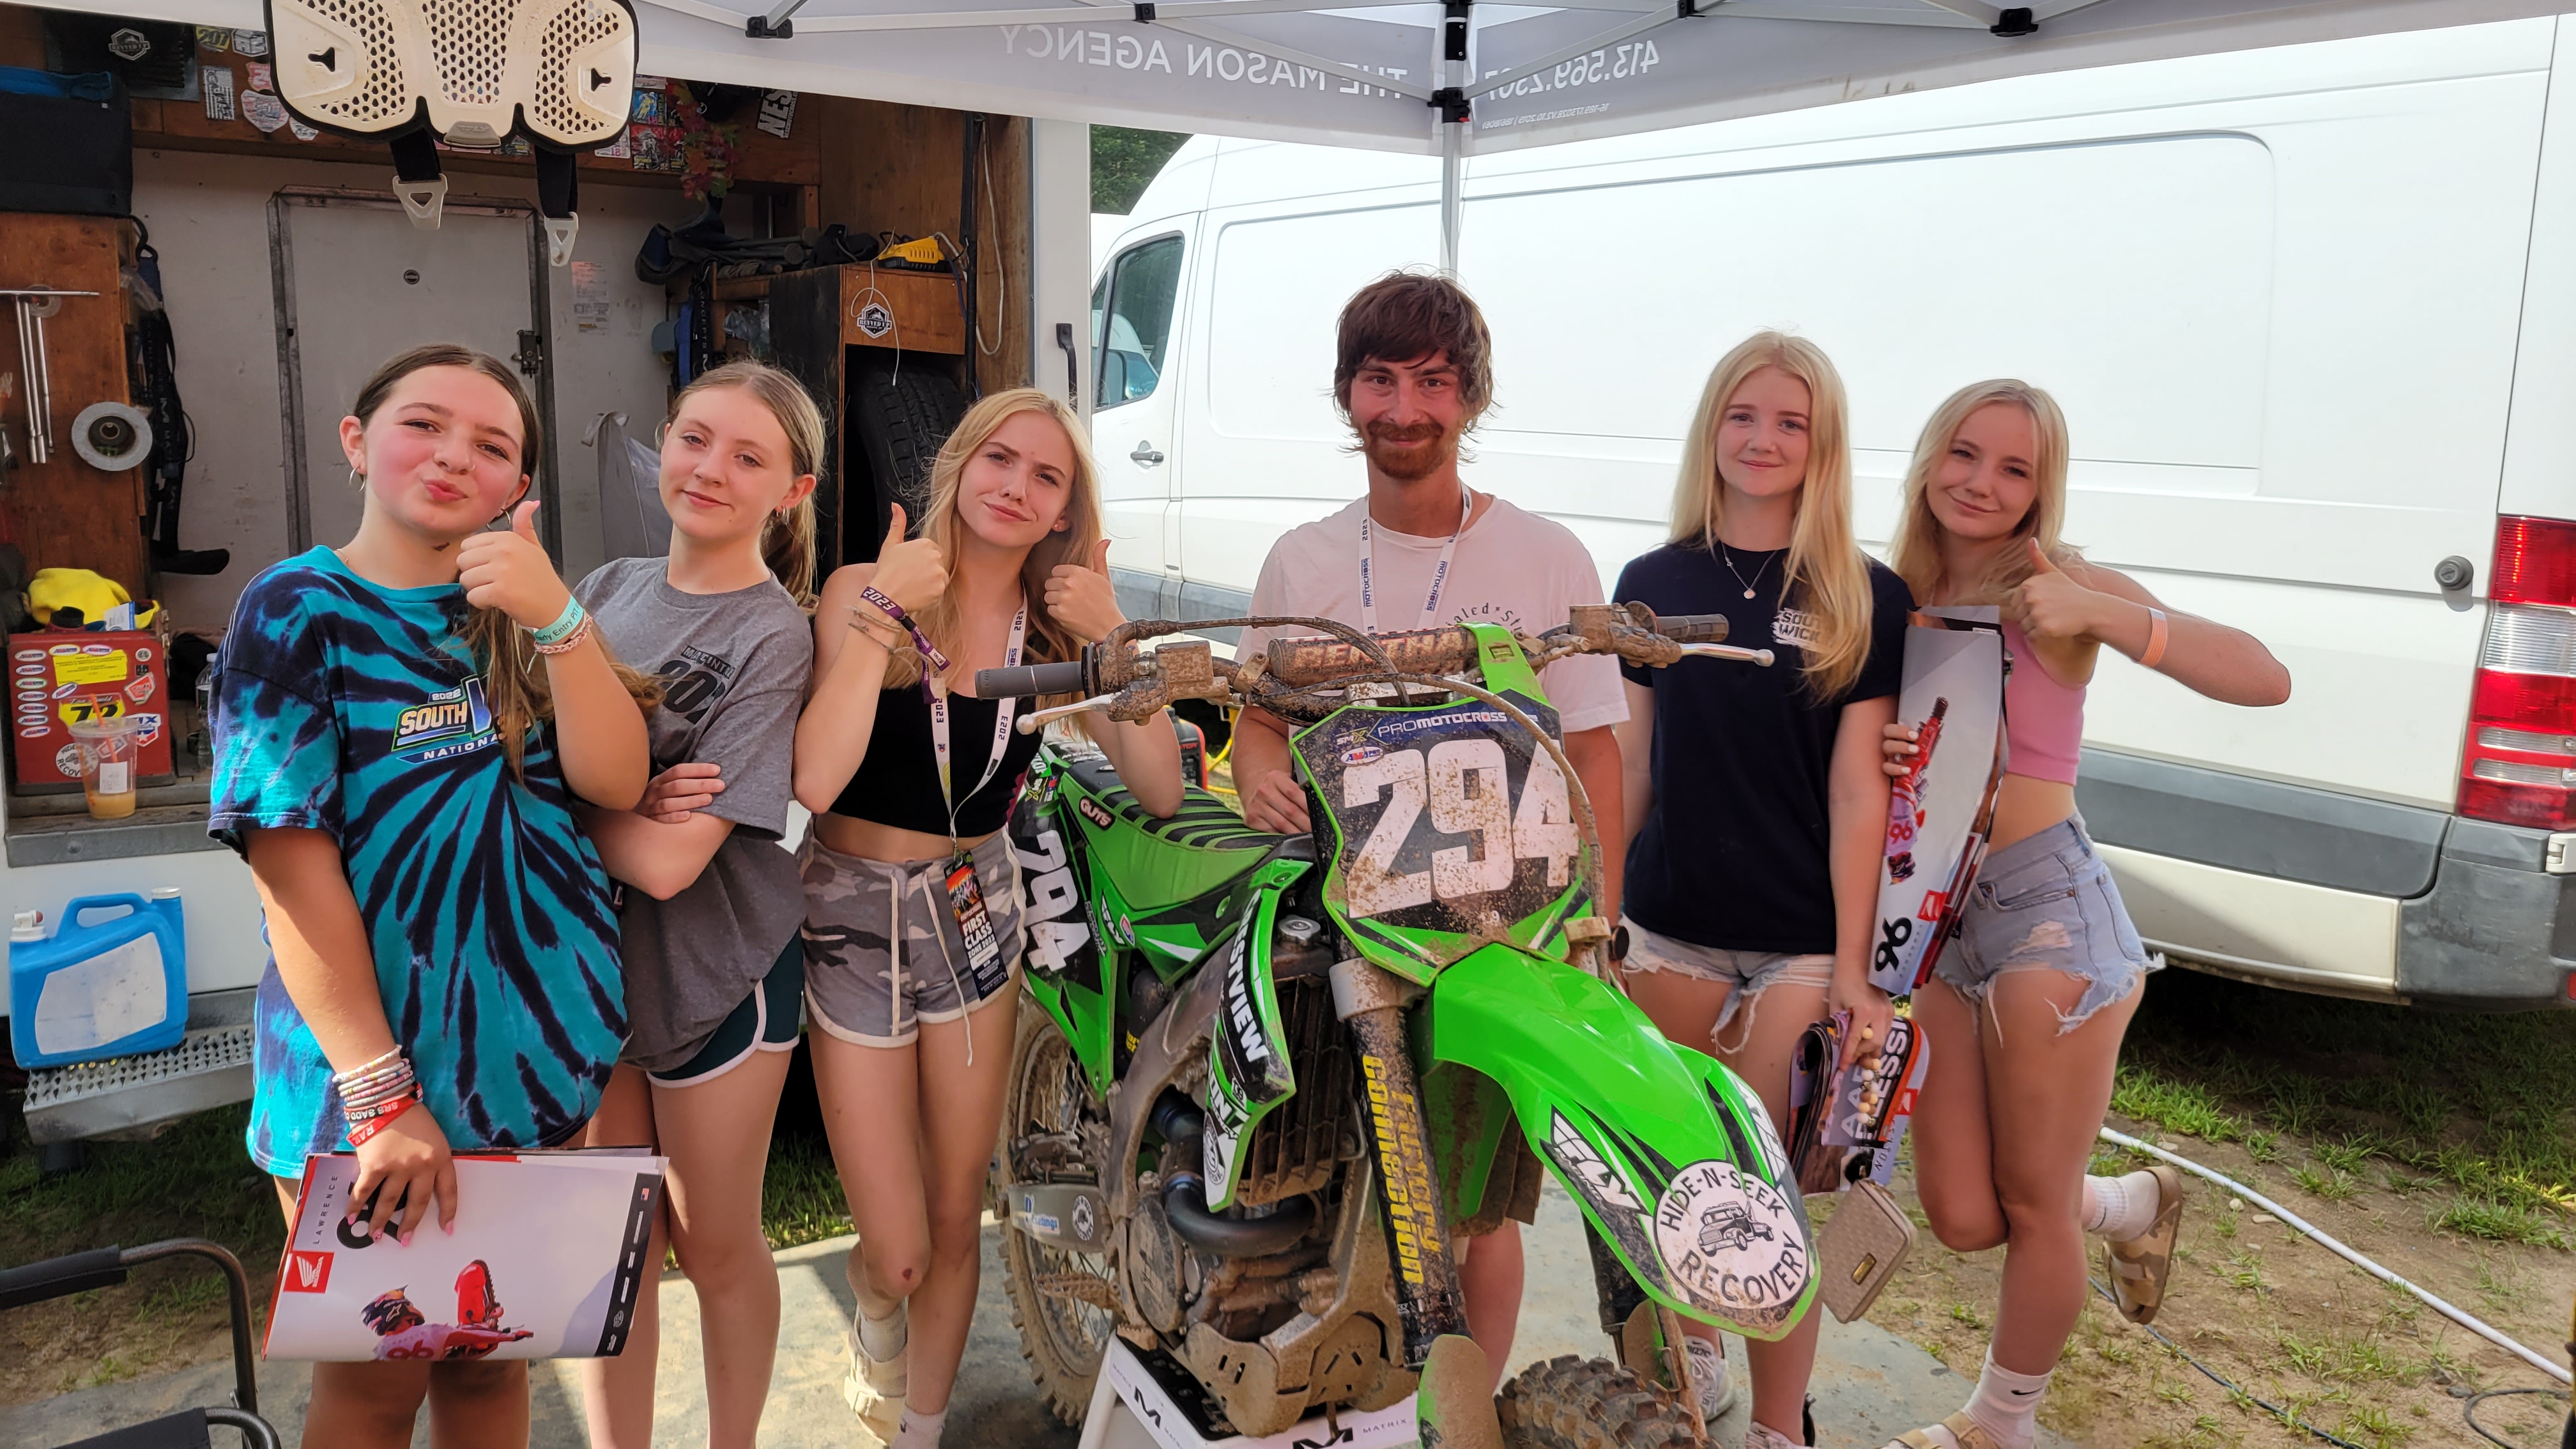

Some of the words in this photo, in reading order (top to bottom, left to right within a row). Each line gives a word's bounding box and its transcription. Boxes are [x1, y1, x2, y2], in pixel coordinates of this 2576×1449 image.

[700, 291, 708, 349] ONCEPTS
[862, 588, 897, 611] 2023
[1425, 560, 1446, 611] MOTOCROSS
[552, 618, 574, 637] Entry
[1014, 610, 1024, 631] 2023
[431, 687, 462, 701] 2022
[399, 700, 468, 736] SOUTH
[935, 698, 945, 724] 2023
[998, 715, 1009, 740] 2023
[1336, 730, 1368, 746] SMX
[1080, 798, 1116, 827] GUTS
[1342, 737, 1581, 919] 294
[1016, 830, 1092, 972] 294
[962, 910, 987, 937] FIRST
[965, 923, 993, 951] CLASS
[967, 944, 983, 959] ZONE
[1874, 916, 1912, 973] 96
[1228, 889, 1270, 1064] CRESTVIEW
[312, 1174, 338, 1245] LAWRENCE
[1659, 1167, 1785, 1232] HIDE-N-SEEK
[1678, 1230, 1804, 1305] RECOVERY
[1362, 1418, 1407, 1434] MATRIX
